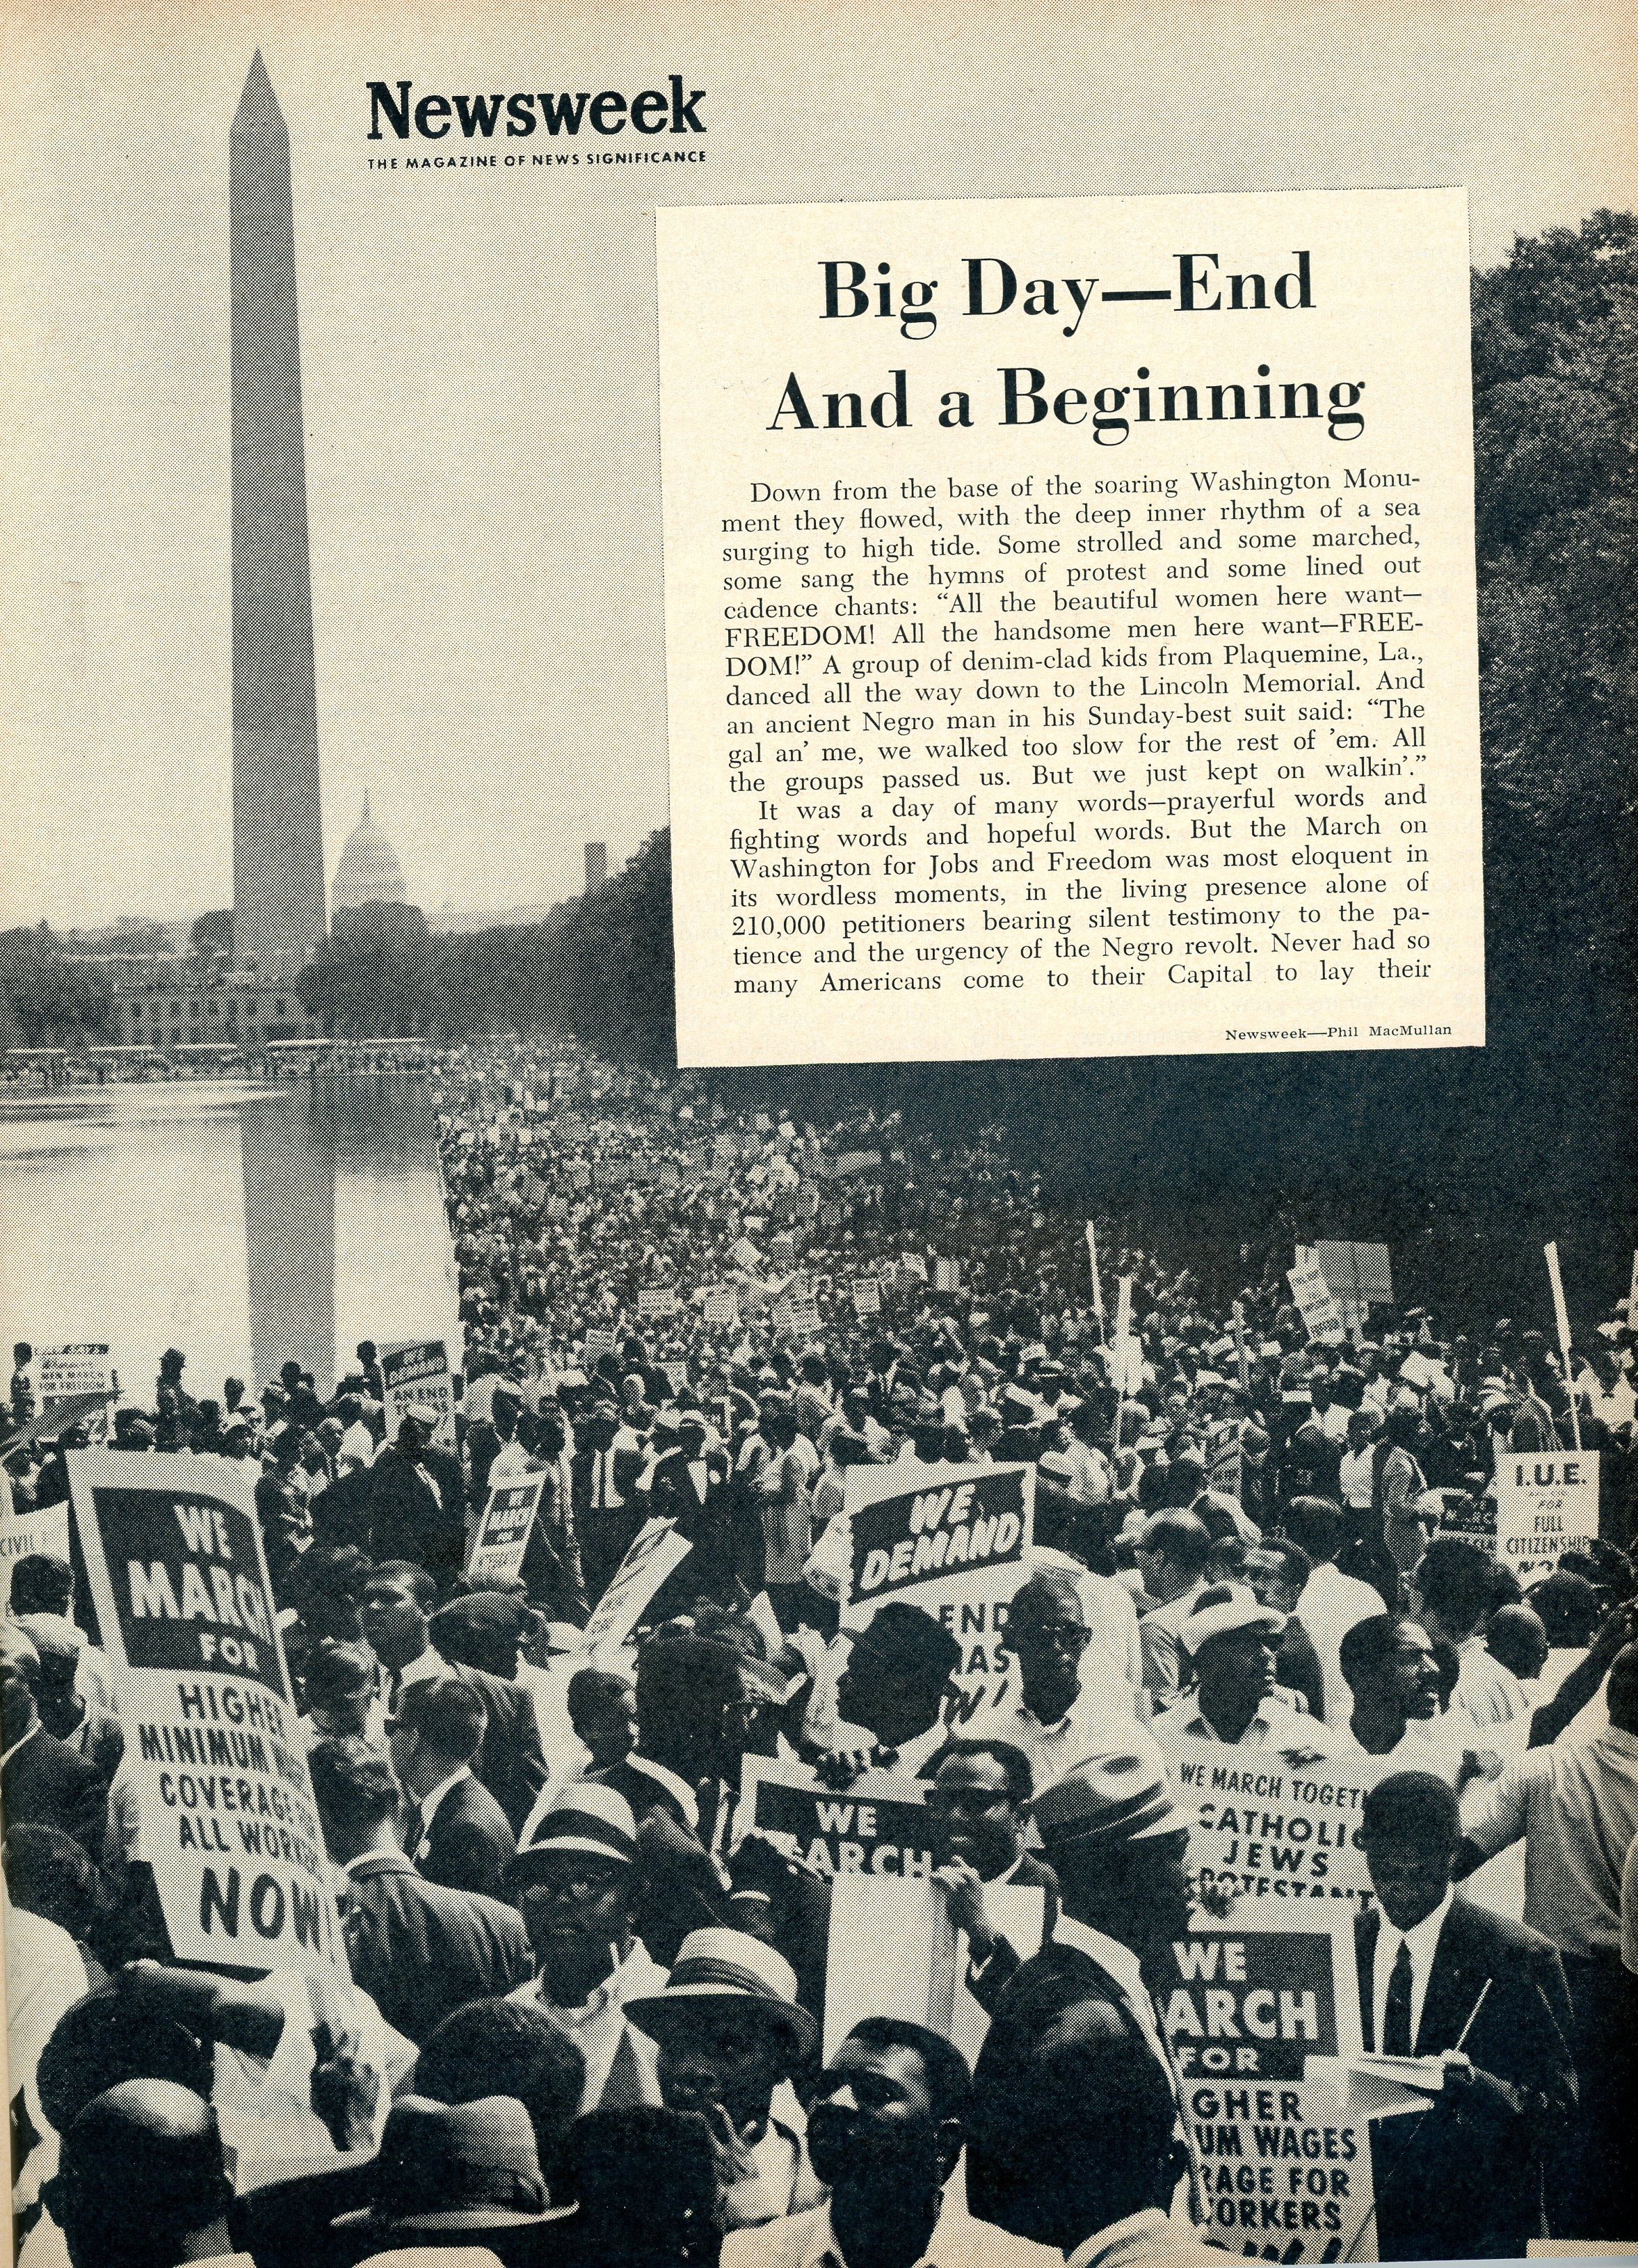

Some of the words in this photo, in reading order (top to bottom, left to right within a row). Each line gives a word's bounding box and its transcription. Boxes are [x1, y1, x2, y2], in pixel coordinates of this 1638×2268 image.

[389, 1357, 446, 1385] DEMAND
[403, 1347, 426, 1364] WE
[394, 1389, 413, 1401] AN
[417, 1387, 448, 1398] END
[1515, 1462, 1587, 1487] I.U.E.
[488, 1507, 531, 1531] MARCH
[909, 1483, 977, 1535] WE
[1537, 1499, 1564, 1510] FOR
[174, 1503, 232, 1560] WE
[1534, 1515, 1564, 1533] FULL
[860, 1512, 1021, 1591] DEMAND
[1507, 1535, 1591, 1556] CITIZENSHIP
[127, 1558, 273, 1646] MARCH
[938, 1602, 1014, 1634] END
[198, 1633, 261, 1672] FOR
[177, 1683, 287, 1740] HIGHER
[138, 1723, 271, 1775] MINIMUM
[159, 1772, 295, 1825] COVERAGE
[1180, 1762, 1206, 1788] WE
[1211, 1767, 1283, 1799] MARCH
[179, 1813, 231, 1853] ALL
[814, 1800, 878, 1838] WE
[805, 1837, 933, 1878] ARCH
[1223, 1840, 1330, 1878] JEWS
[199, 1865, 337, 1965] NOW!
[1172, 1941, 1247, 1981] WE
[1166, 1988, 1319, 2041] ARCH
[1178, 2046, 1260, 2072] FOR
[1191, 2089, 1303, 2121] GHER
[1253, 2126, 1358, 2162] WAGES
[1289, 2167, 1351, 2197] FOR
[1210, 2198, 1342, 2231] ORKERS
